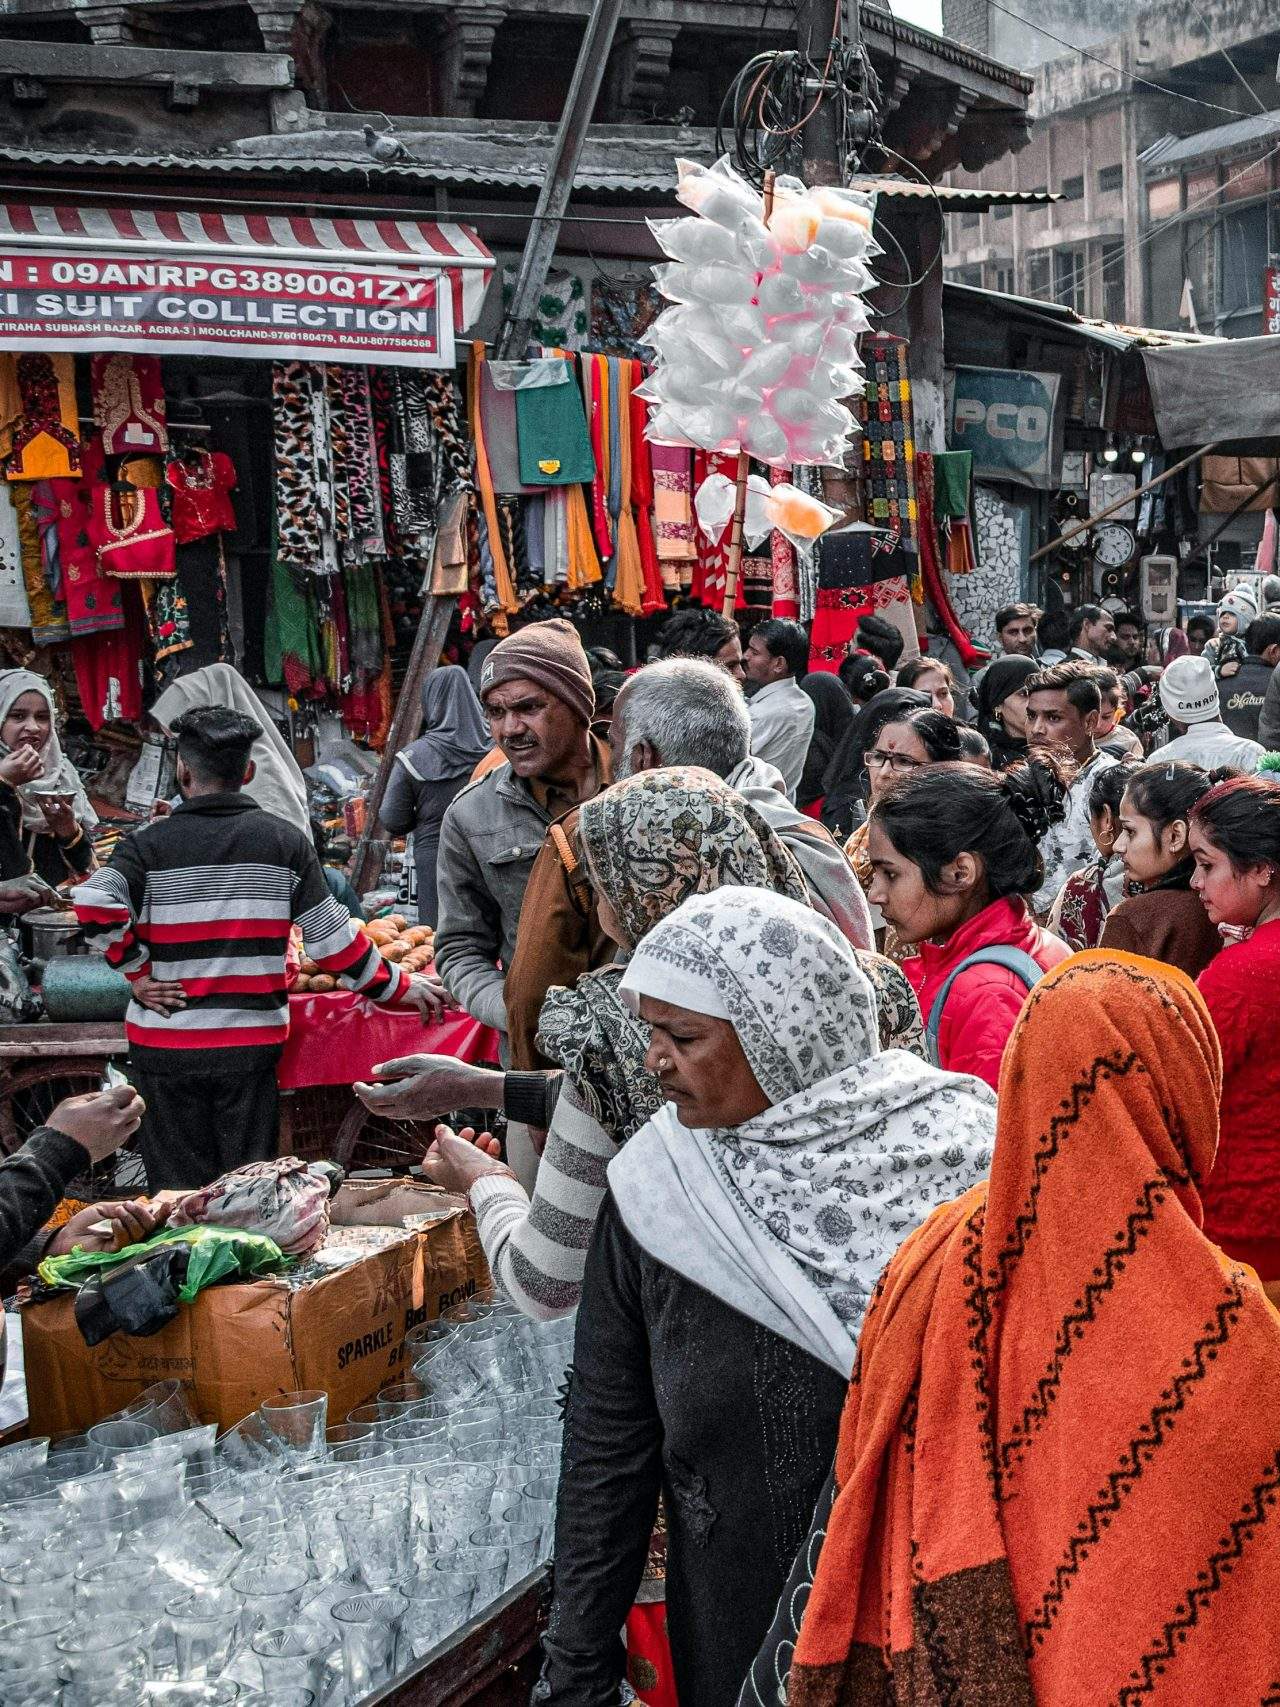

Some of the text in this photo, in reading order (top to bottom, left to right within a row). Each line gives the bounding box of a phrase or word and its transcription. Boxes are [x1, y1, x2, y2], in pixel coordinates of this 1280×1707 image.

[52, 262, 426, 302] 09ANRPG3890Q1ZY
[36, 293, 143, 317] SUIT
[157, 297, 428, 332] COLLECTION
[45, 323, 101, 333] SUBHASH
[104, 325, 146, 334] BAZAR,
[149, 326, 190, 335] AGRA-3
[955, 398, 1048, 442] PCO
[337, 1321, 394, 1370] SPARKLE
